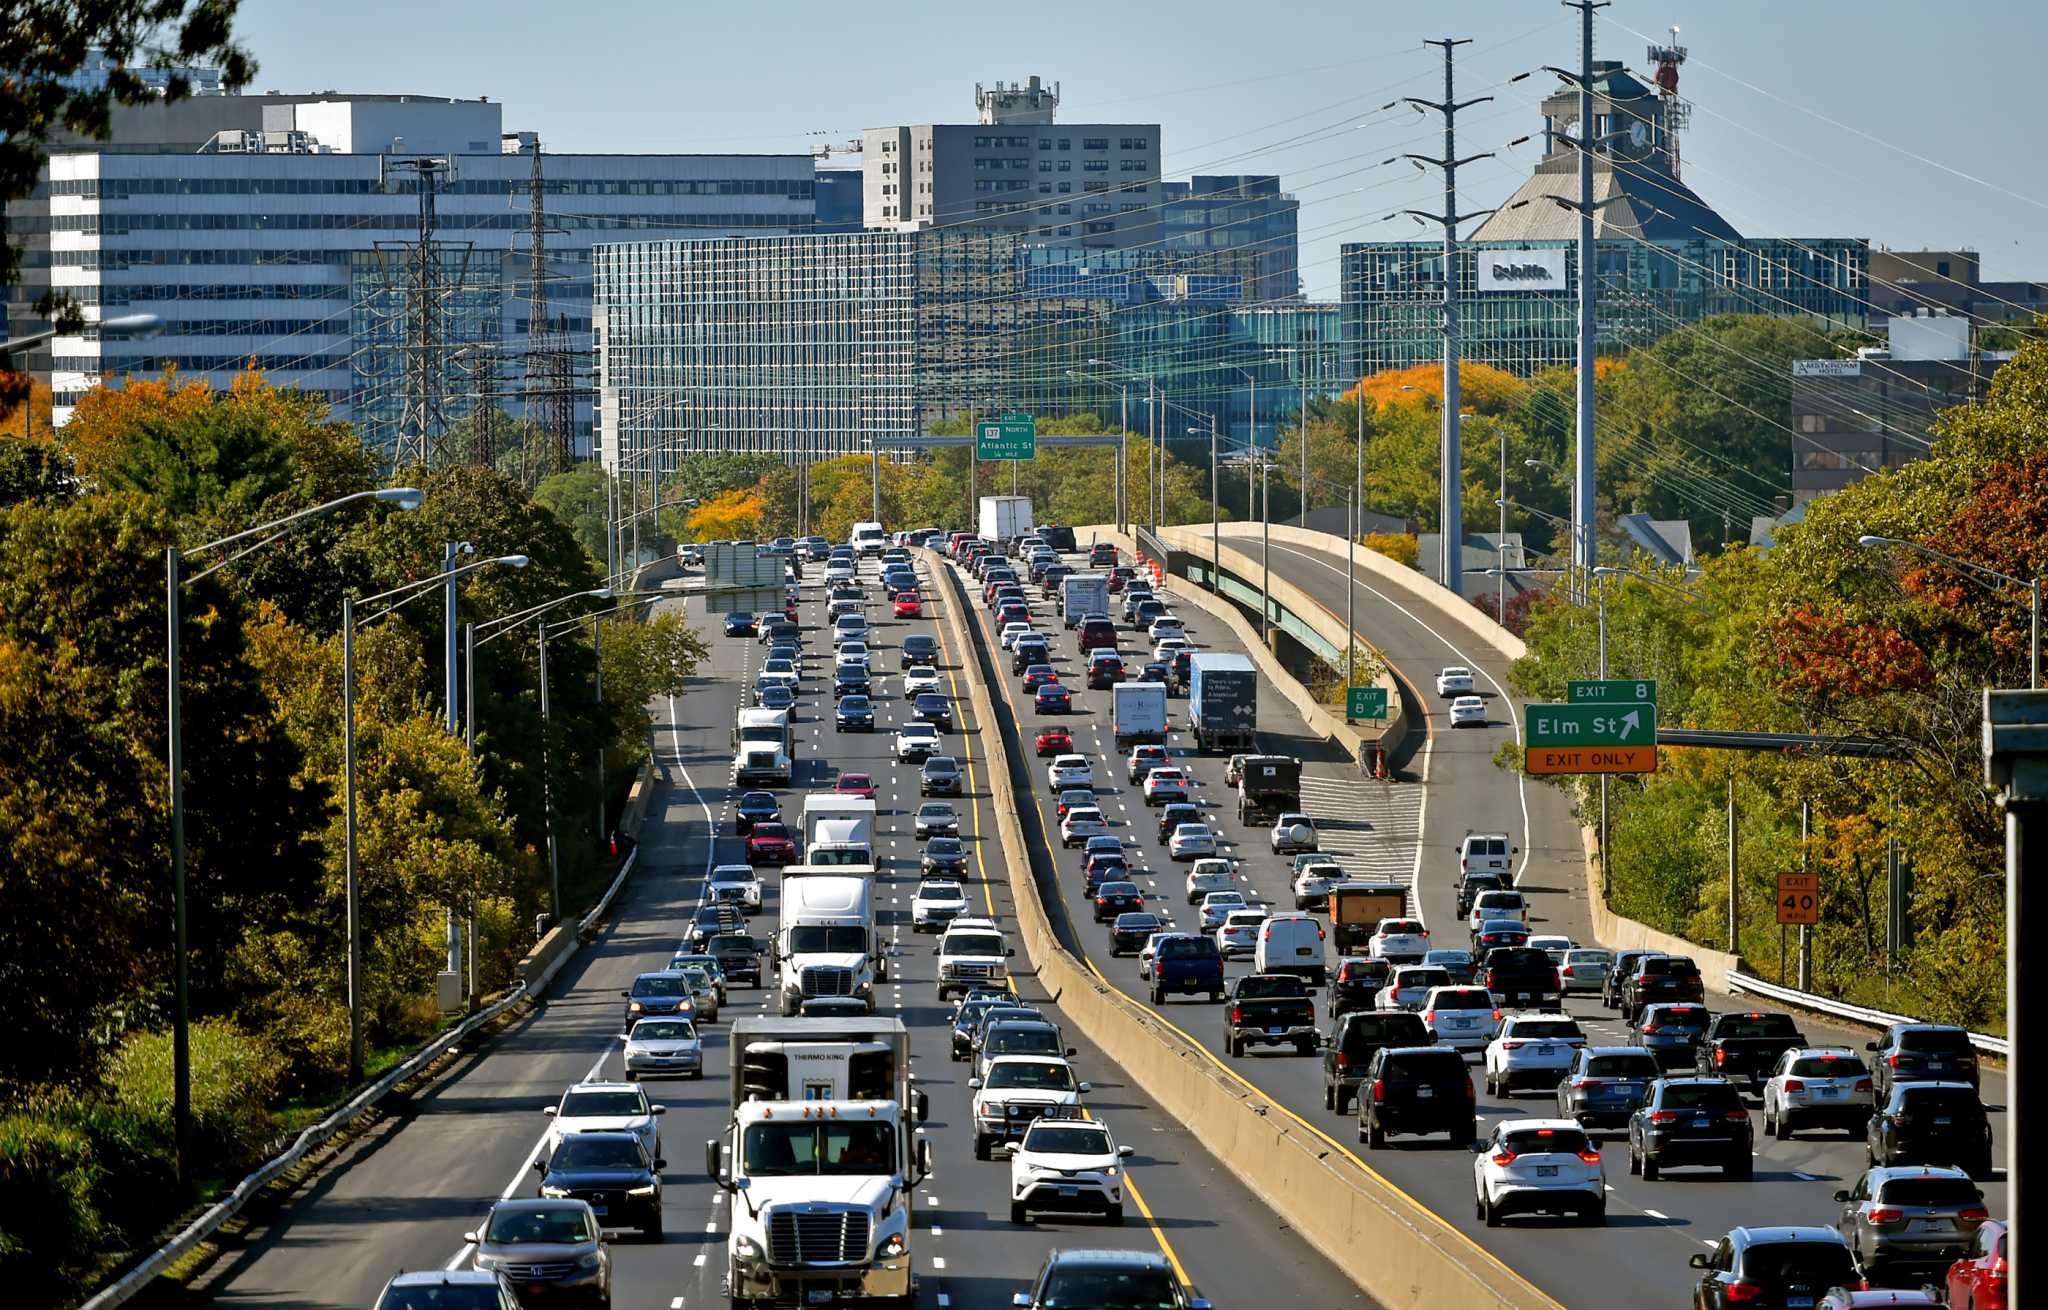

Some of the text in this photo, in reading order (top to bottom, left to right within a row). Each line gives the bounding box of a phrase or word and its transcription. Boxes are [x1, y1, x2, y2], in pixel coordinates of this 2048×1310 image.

[1356, 692, 1378, 700] EXIT
[1576, 684, 1647, 698] EXIT 8
[1356, 704, 1364, 714] 8
[1538, 718, 1616, 734] Elm St
[1546, 752, 1636, 766] EXIT ONLY
[1786, 878, 1808, 886] EXIT
[1782, 896, 1813, 910] 40
